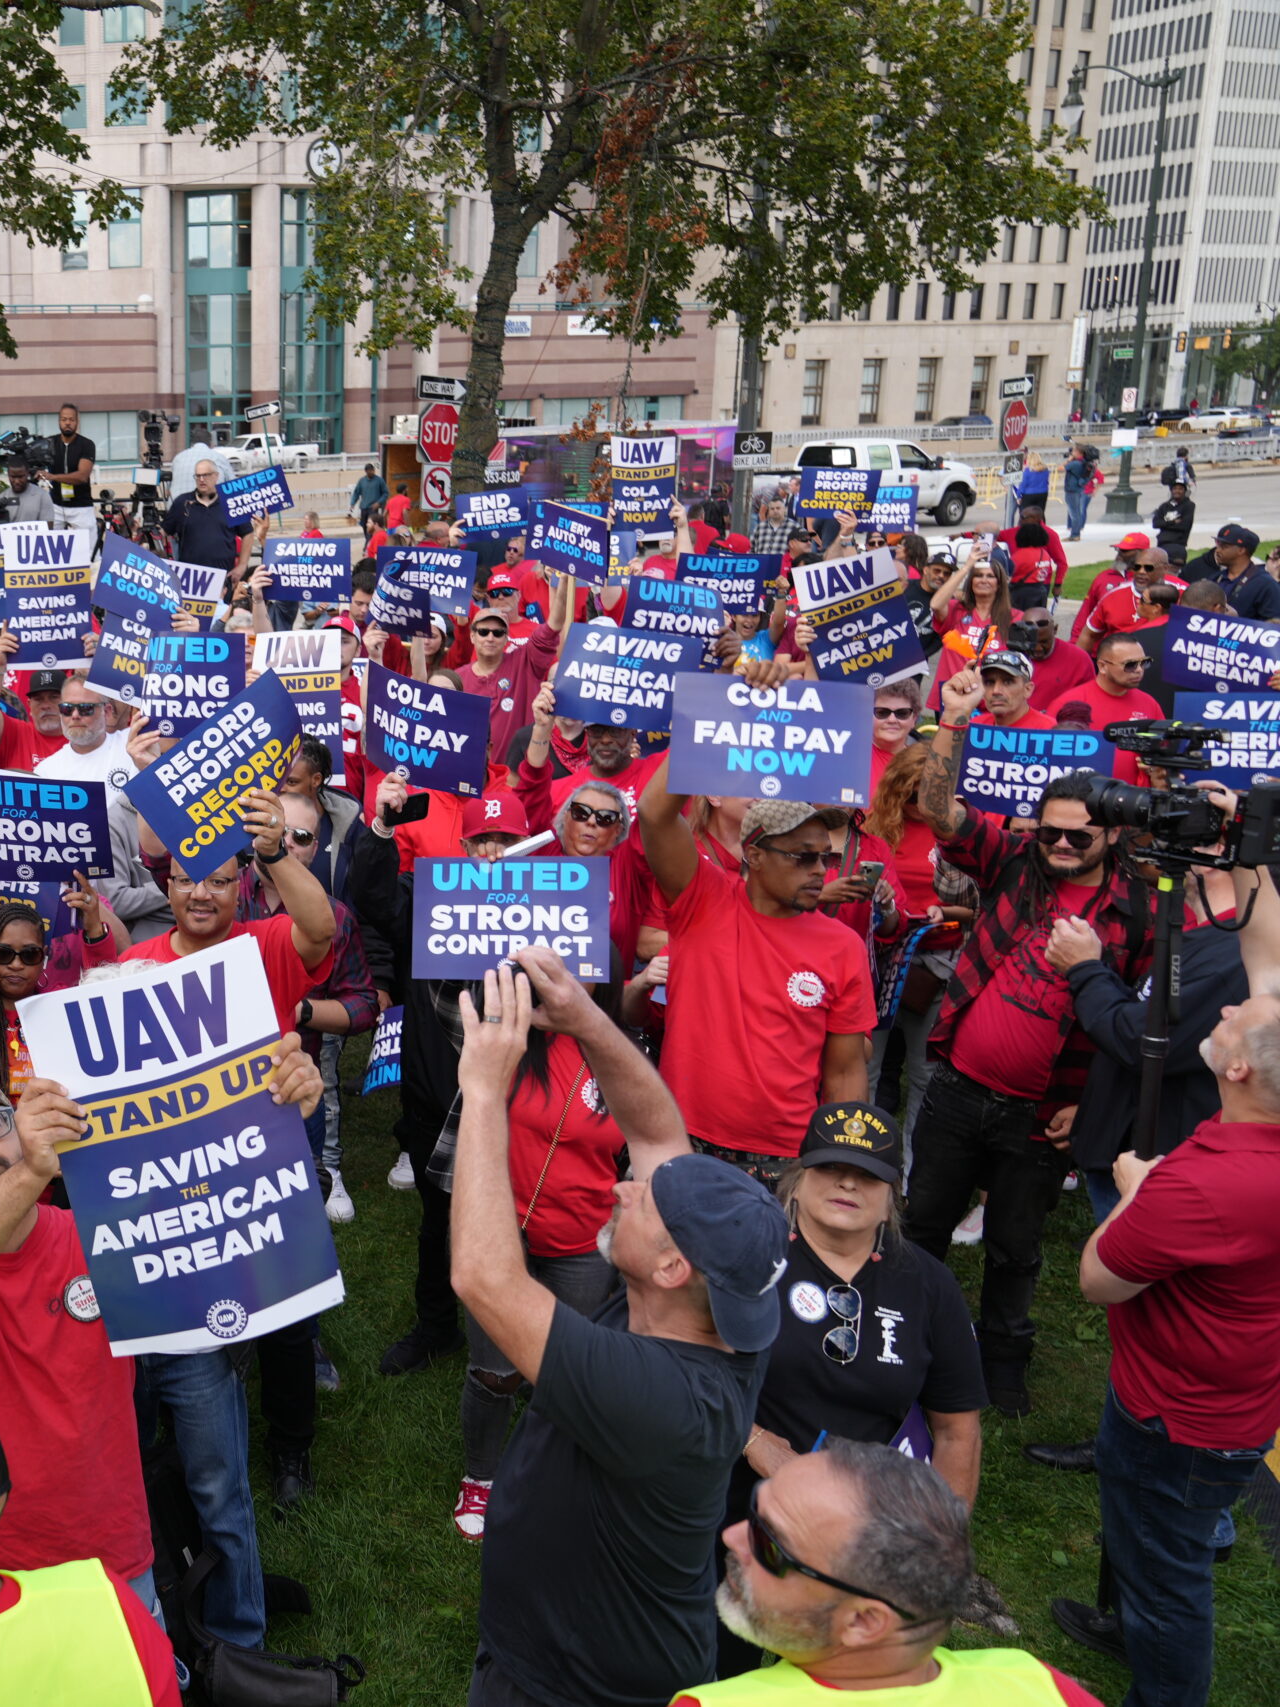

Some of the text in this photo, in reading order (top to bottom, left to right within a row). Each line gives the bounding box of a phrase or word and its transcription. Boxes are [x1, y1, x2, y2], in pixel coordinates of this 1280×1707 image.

[441, 384, 454, 393] WAY
[1005, 416, 1026, 436] STOP
[620, 441, 663, 463] UAW
[734, 456, 769, 467] BIKE LANE
[222, 470, 277, 495] UNITED
[616, 469, 649, 478] STAND
[814, 480, 867, 491] PROFITS
[817, 471, 868, 481] RECORD
[227, 484, 282, 508] STRONG
[470, 493, 510, 512] END
[548, 526, 576, 543] AUTO
[558, 517, 591, 537] EVERY
[17, 534, 74, 564] UAW
[275, 543, 336, 556] SAVING
[394, 551, 462, 567] SAVING
[686, 558, 760, 572] UNITED
[9, 574, 59, 586] STAND
[281, 576, 331, 588] DREAM
[806, 556, 874, 601] UAW
[154, 581, 180, 604] JOB
[639, 581, 717, 609] UNITED
[871, 586, 894, 602] UP
[1186, 615, 1279, 647] SAVING
[265, 634, 326, 669] UAW
[816, 642, 866, 669] FAIR
[1187, 658, 1260, 686] DREAM
[386, 678, 446, 716] COLA
[579, 681, 665, 709] DREAM
[373, 705, 408, 740] FAIR
[414, 723, 469, 753] PAY
[694, 720, 851, 754] FAIR PAY
[1109, 727, 1139, 735] DEITY
[154, 702, 256, 787] RECORD
[970, 727, 1099, 757] UNITED
[168, 718, 271, 807] PROFITS
[727, 748, 816, 776] NOW
[186, 739, 282, 824] RECORD
[2, 808, 26, 818] FOR
[432, 863, 589, 891] UNITED
[486, 894, 515, 904] FOR
[430, 905, 588, 932] STRONG
[1171, 955, 1180, 996] GITZO
[64, 963, 228, 1078] UAW
[79, 1083, 210, 1141] STAND
[824, 1109, 888, 1134] U.S. ARMY
[834, 1135, 873, 1148] VETERAN
[108, 1126, 267, 1198] SAVING
[92, 1161, 310, 1255] AMERICAN
[75, 1295, 96, 1309] Strik
[218, 1313, 235, 1323] UAW
